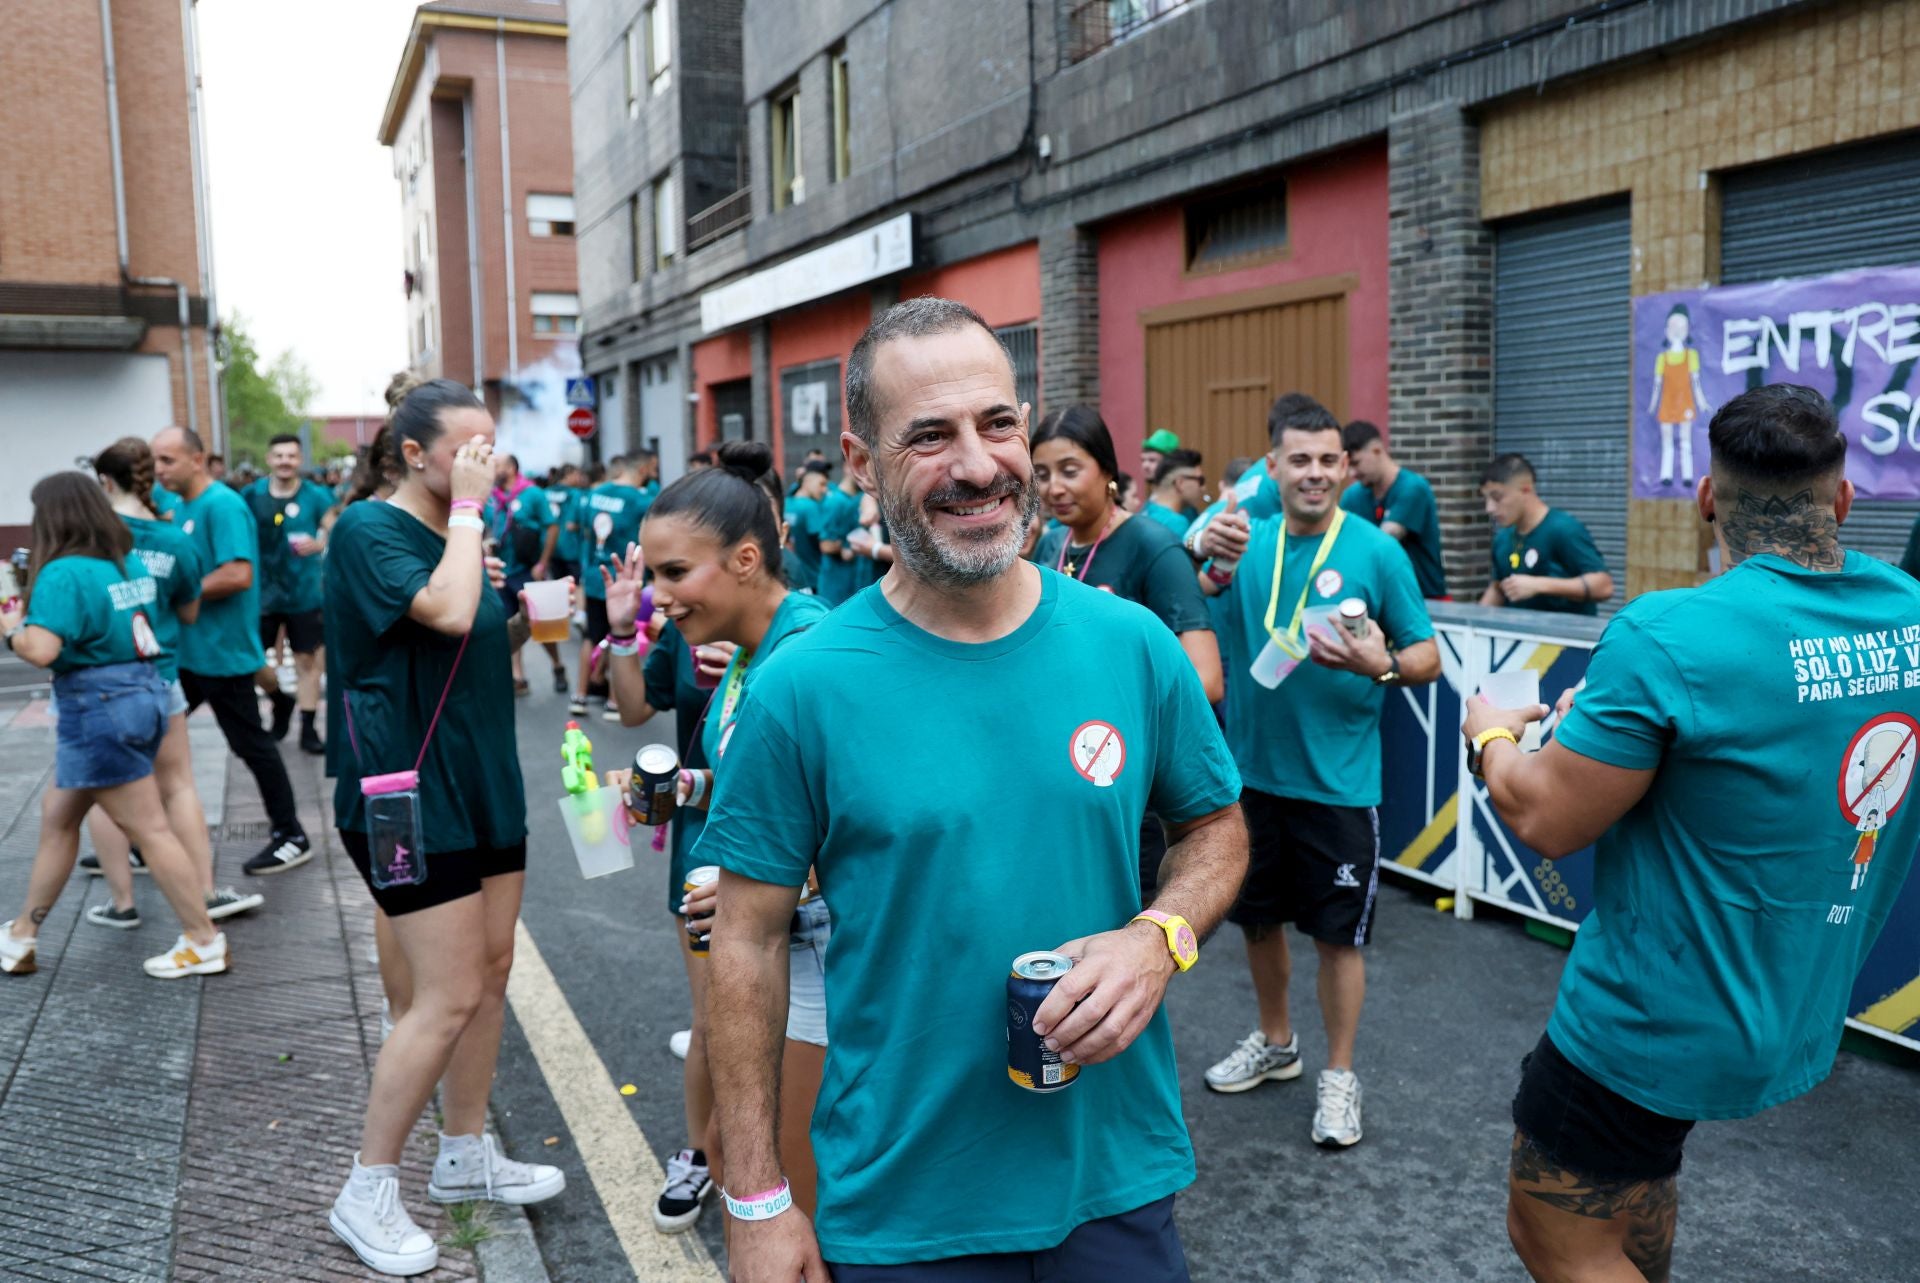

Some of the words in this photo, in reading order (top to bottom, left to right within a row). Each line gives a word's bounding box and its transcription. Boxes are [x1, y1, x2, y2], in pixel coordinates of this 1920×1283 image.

[1722, 302, 1920, 375] ENTRE
[1789, 638, 1825, 658] HOY
[1828, 636, 1851, 654] NO
[1853, 631, 1887, 651] HAY
[1892, 624, 1920, 646] LUZ
[1794, 653, 1853, 683] SOLO
[1856, 647, 1900, 676] LUZ
[1797, 680, 1843, 703] PARA
[1847, 672, 1899, 697] SEGUIR
